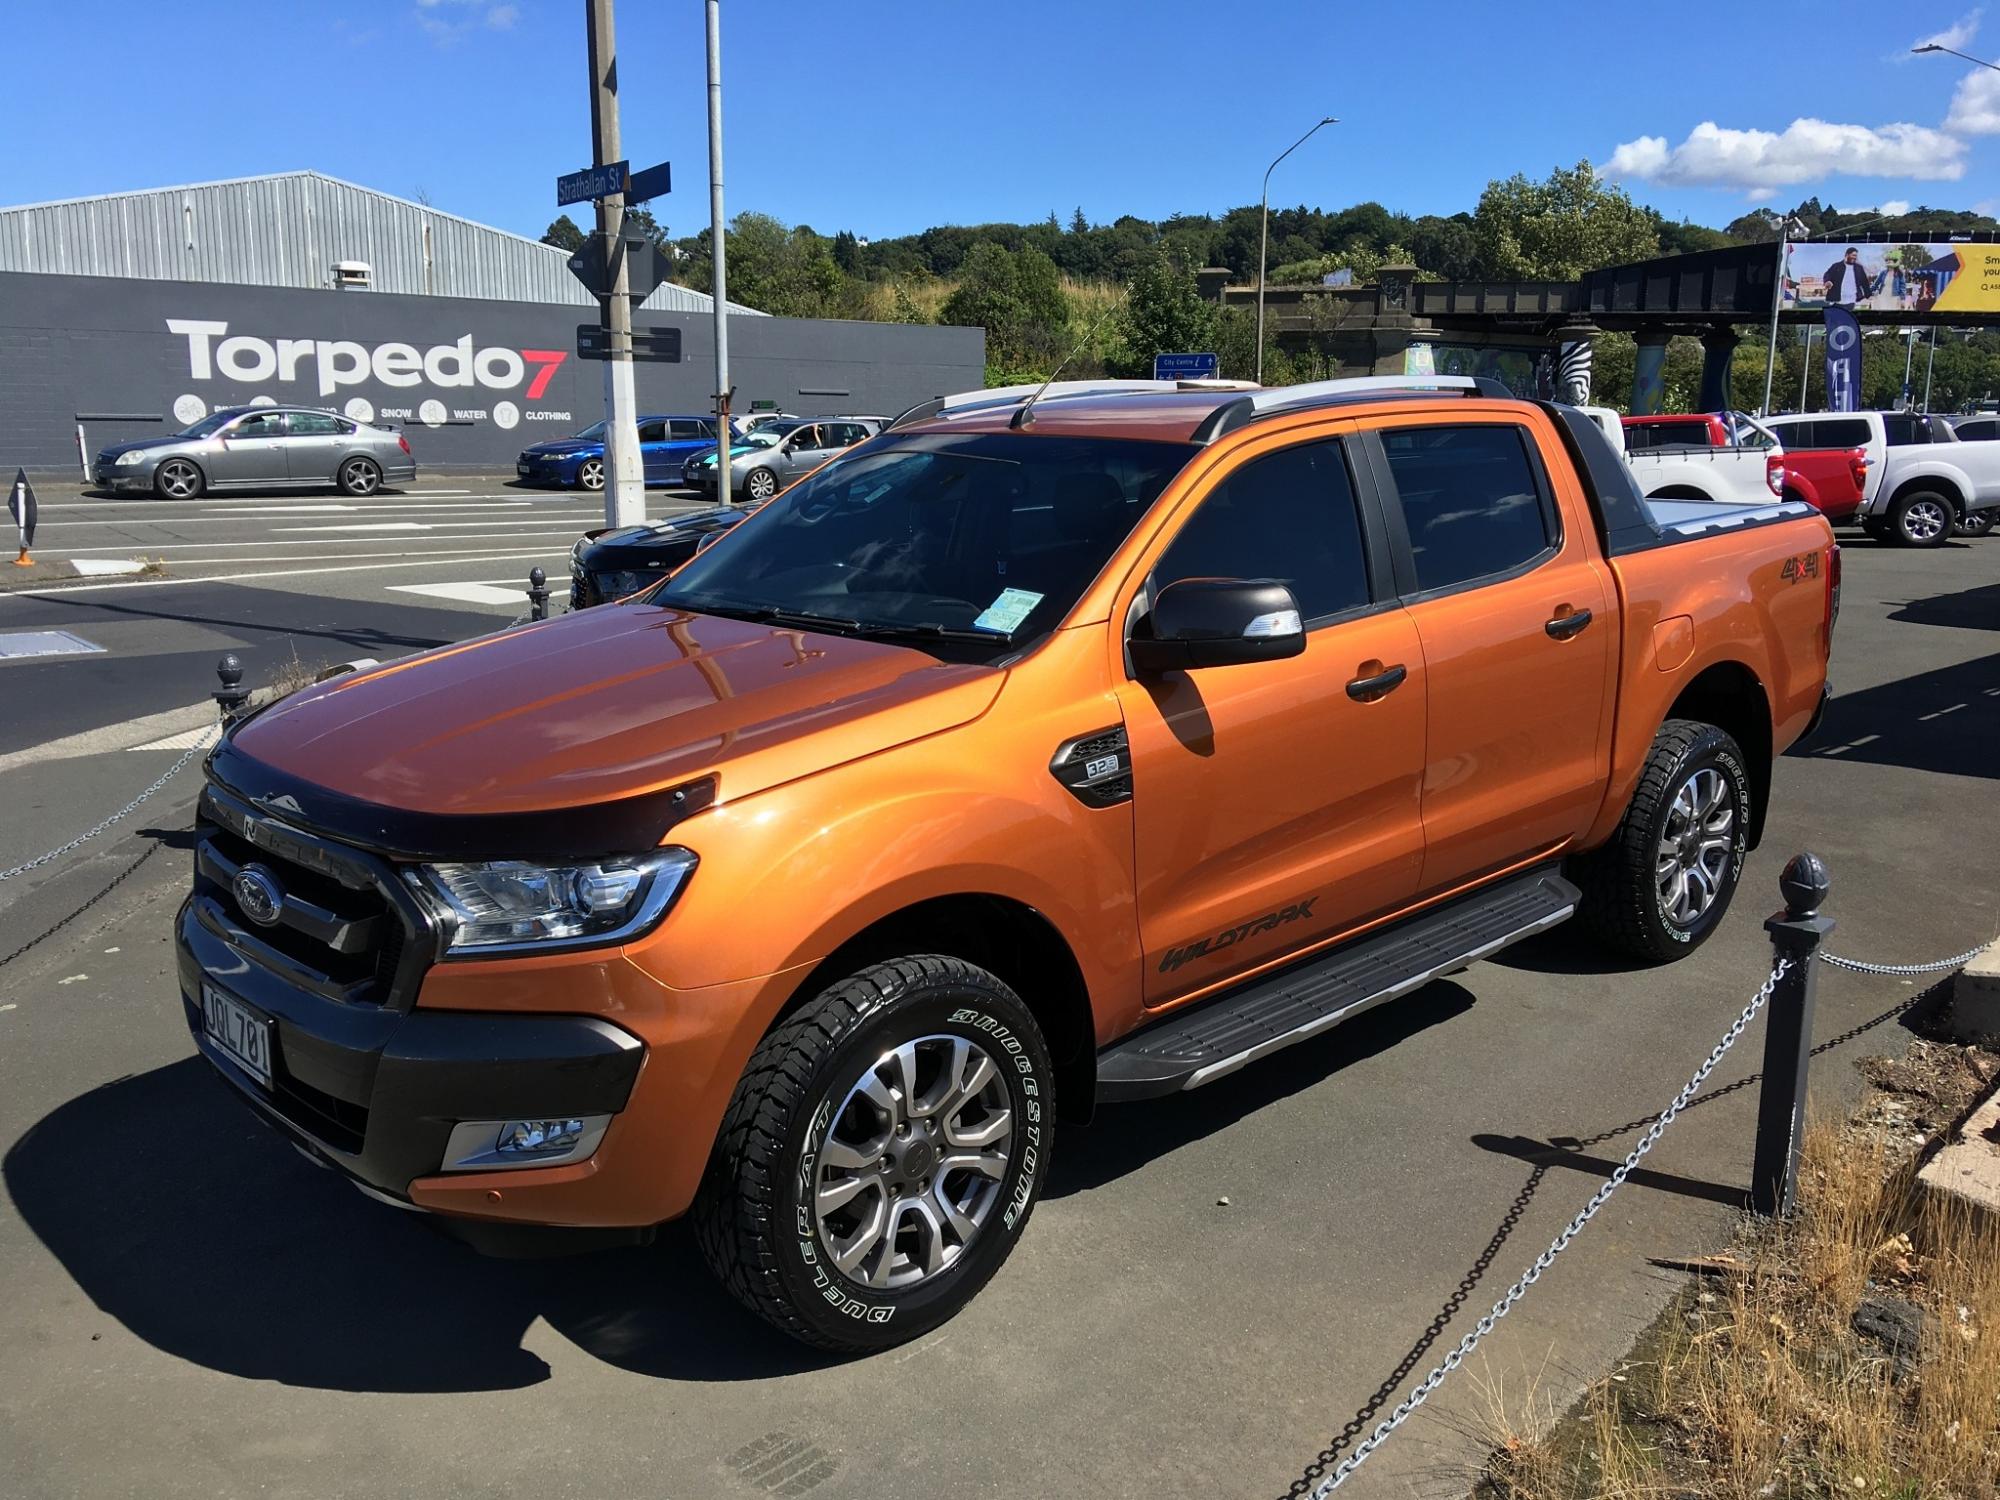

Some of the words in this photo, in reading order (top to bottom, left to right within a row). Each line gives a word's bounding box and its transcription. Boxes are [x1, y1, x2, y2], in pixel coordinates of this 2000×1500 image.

[559, 173, 606, 201] Strathallan
[608, 167, 620, 191] St
[166, 318, 569, 399] Torpedo7
[381, 408, 412, 418] SNOW
[453, 409, 488, 419] WATER
[525, 411, 571, 421] CLOTHING
[1715, 752, 1749, 825] DUELER
[1158, 895, 1320, 973] WILDTRAK
[206, 992, 269, 1073] JQL701
[947, 1008, 1041, 1231] BRIDGESTONE
[797, 1205, 896, 1323] DUELER
